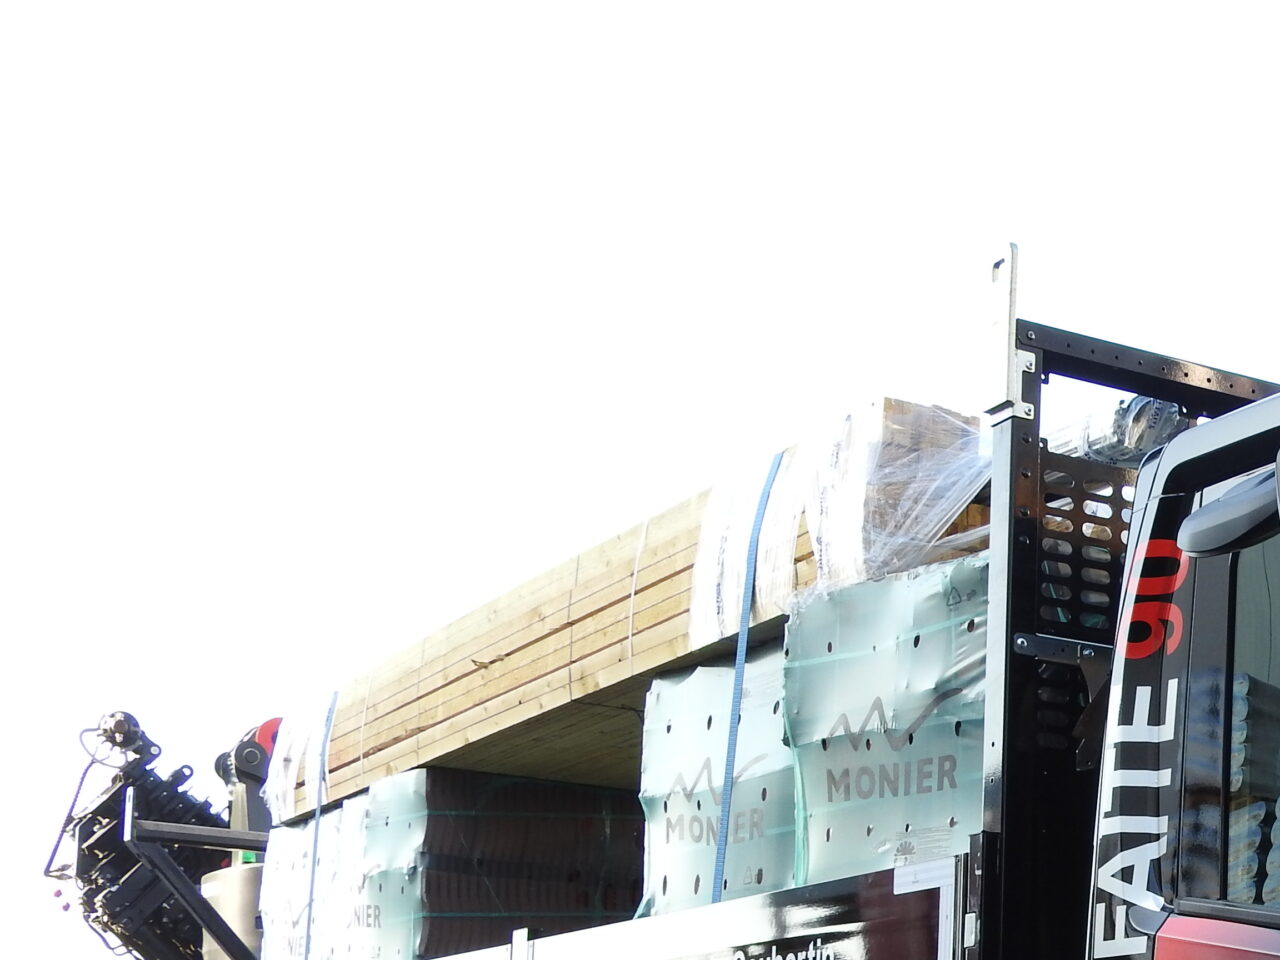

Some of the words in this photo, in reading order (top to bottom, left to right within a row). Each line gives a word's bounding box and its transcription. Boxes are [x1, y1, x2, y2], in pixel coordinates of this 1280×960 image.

[1120, 538, 1190, 660] 90
[826, 754, 958, 803] MONIER
[1093, 677, 1179, 959] FAITE
[665, 807, 764, 847] MONER
